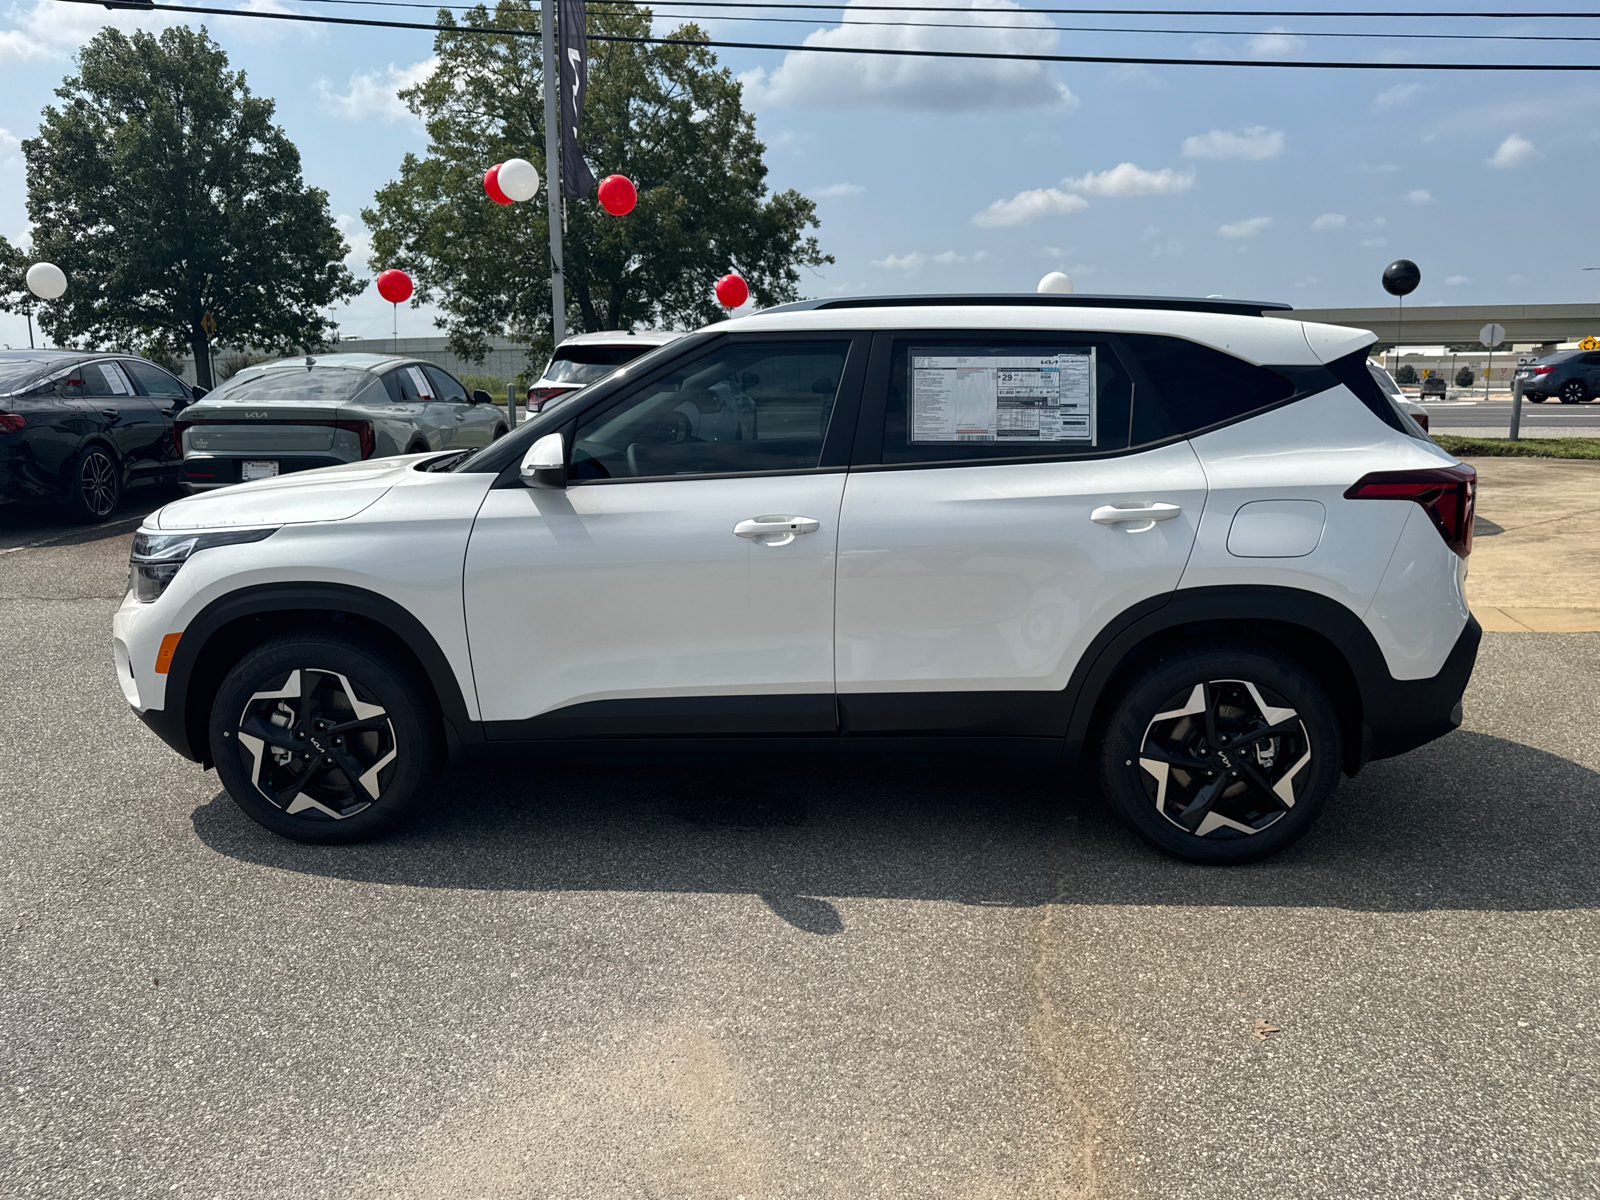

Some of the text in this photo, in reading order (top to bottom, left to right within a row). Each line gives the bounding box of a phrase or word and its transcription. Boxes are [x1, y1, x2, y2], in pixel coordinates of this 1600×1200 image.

[1002, 373, 1013, 382] 29
[245, 411, 268, 419] KIA
[233, 650, 291, 691] SOLUS
[310, 737, 326, 754] KIA
[1217, 750, 1232, 768] KIA
[1310, 741, 1336, 811] KUMHO
